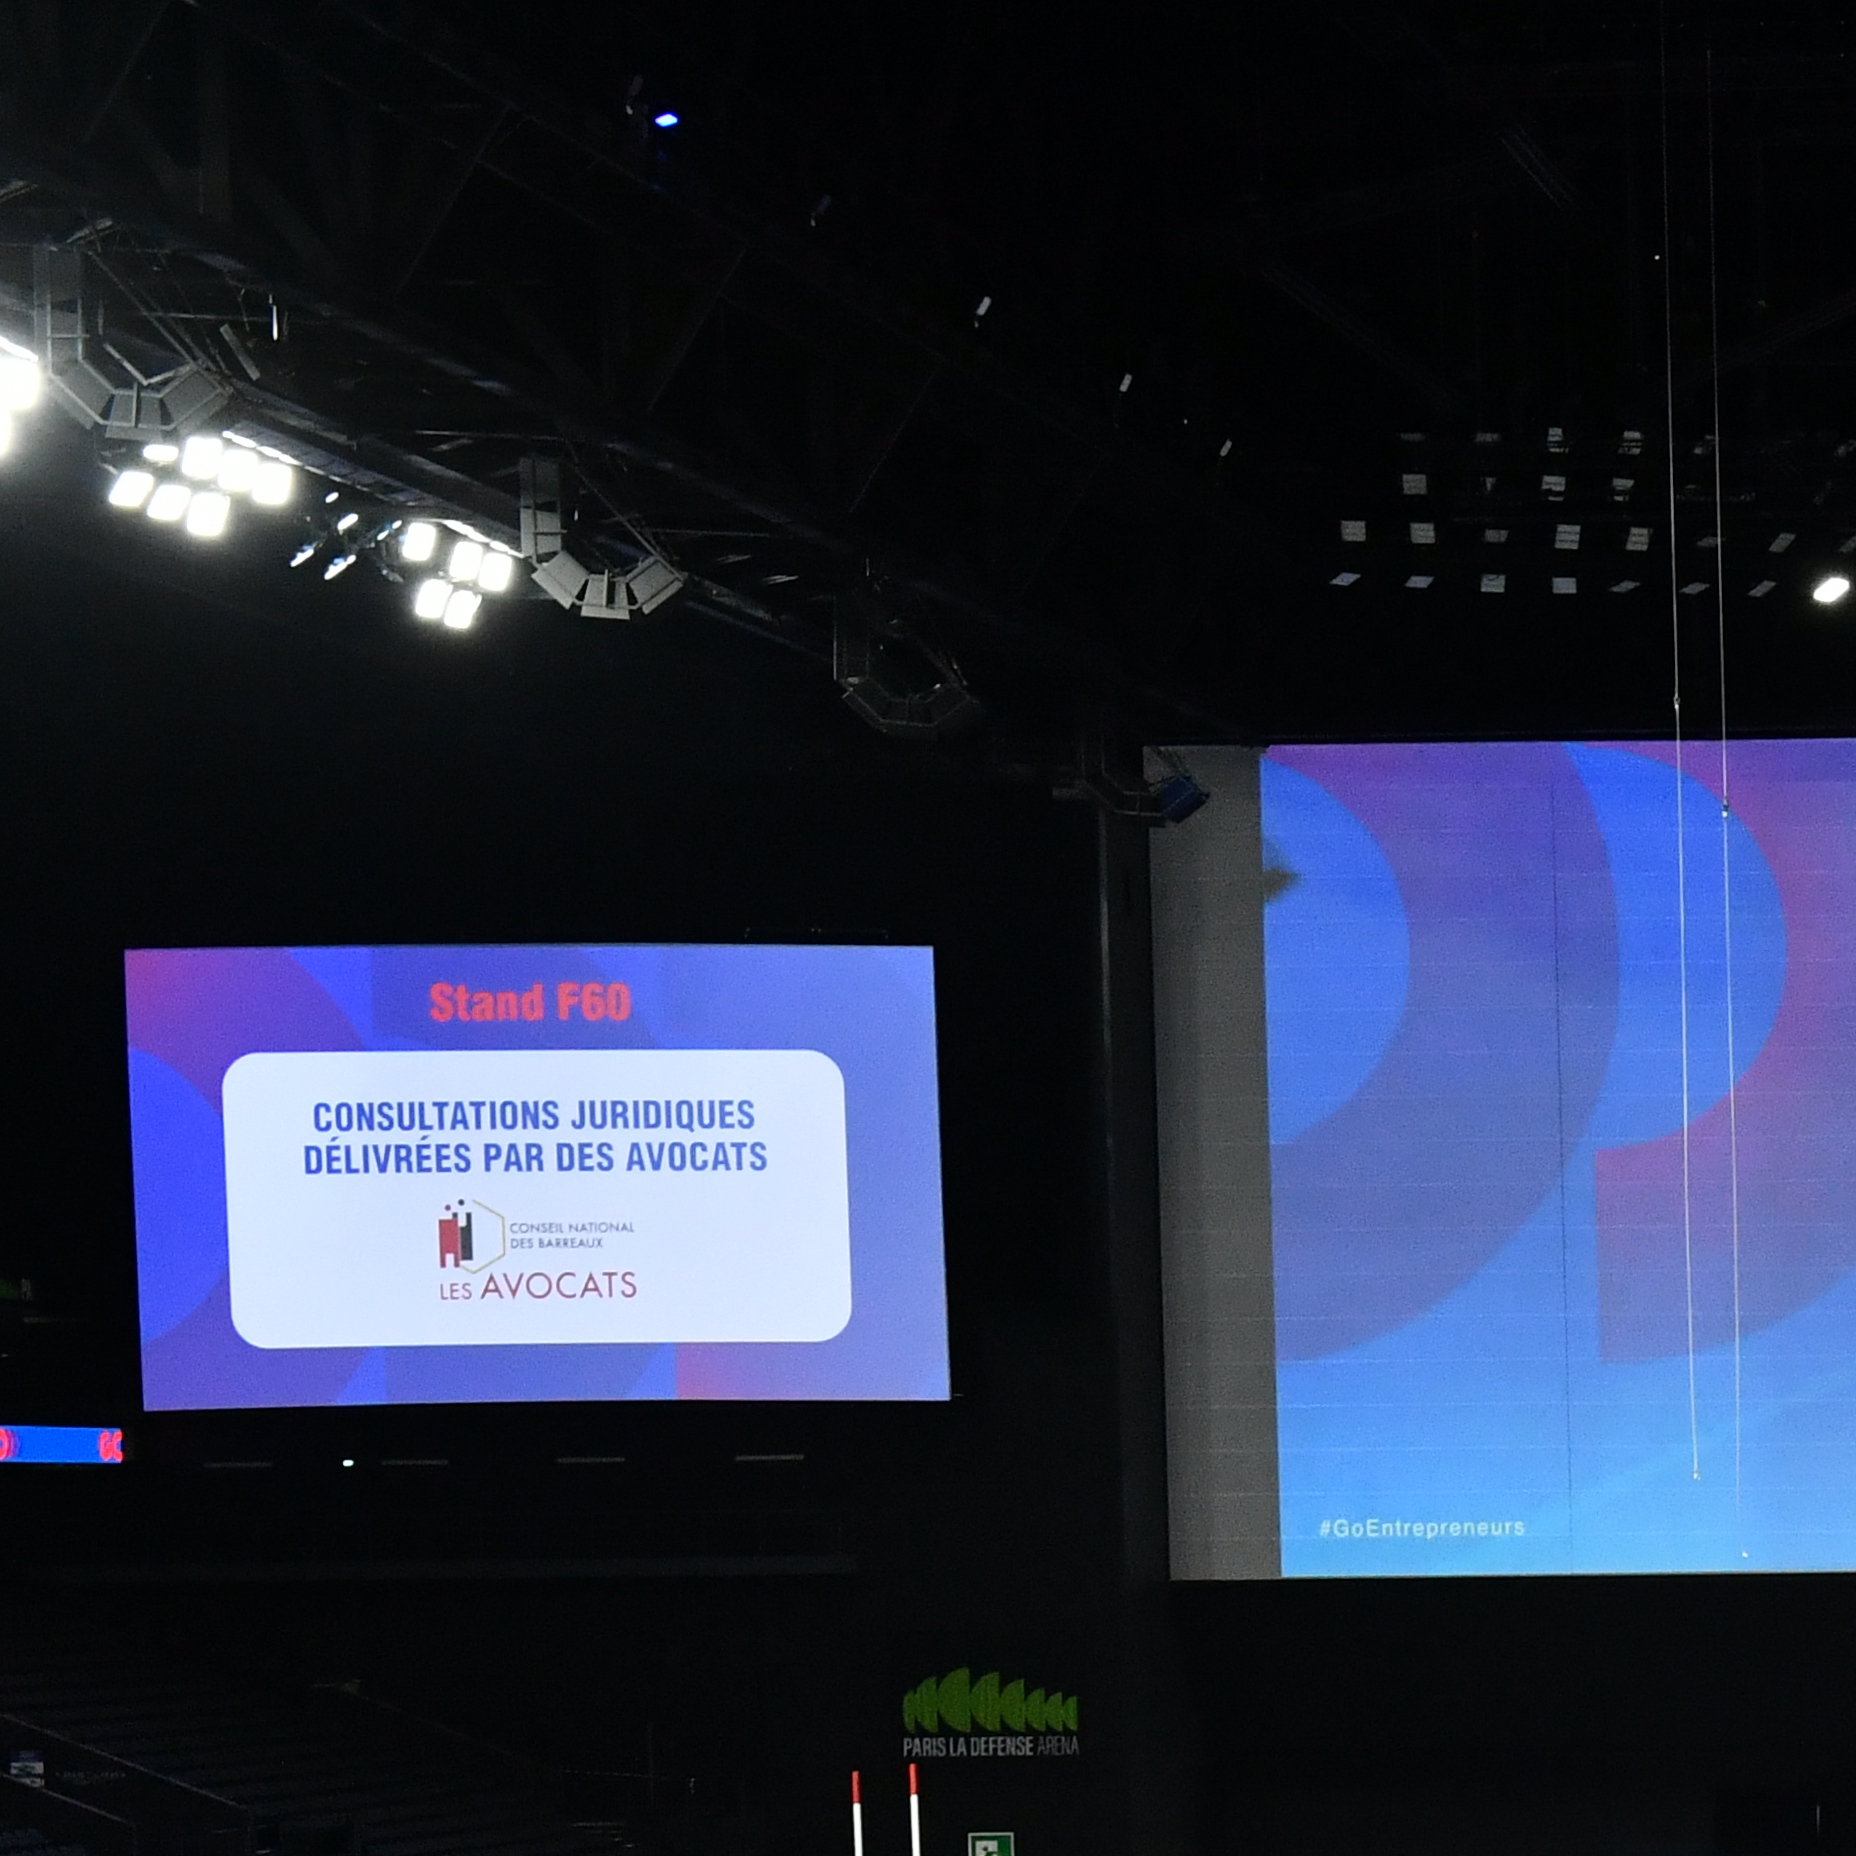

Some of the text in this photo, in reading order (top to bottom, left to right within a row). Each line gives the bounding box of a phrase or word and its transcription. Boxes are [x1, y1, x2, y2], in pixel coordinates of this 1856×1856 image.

[430, 981, 632, 1022] Stand F60
[312, 1098, 756, 1135] CONSULTATIONS JURIDIQUES
[303, 1135, 769, 1176] DÉLIVRÉES PAR DES AVOCATS
[509, 1221, 635, 1234] CONSEIL NATIONAL
[509, 1237, 604, 1249] DES BARREAUX
[439, 1272, 638, 1301] LES AVOCATS
[1319, 1518, 1526, 1540] #GoEntrepreneurs
[903, 1735, 1080, 1757] PARIS LA DEFENSE ARENA
